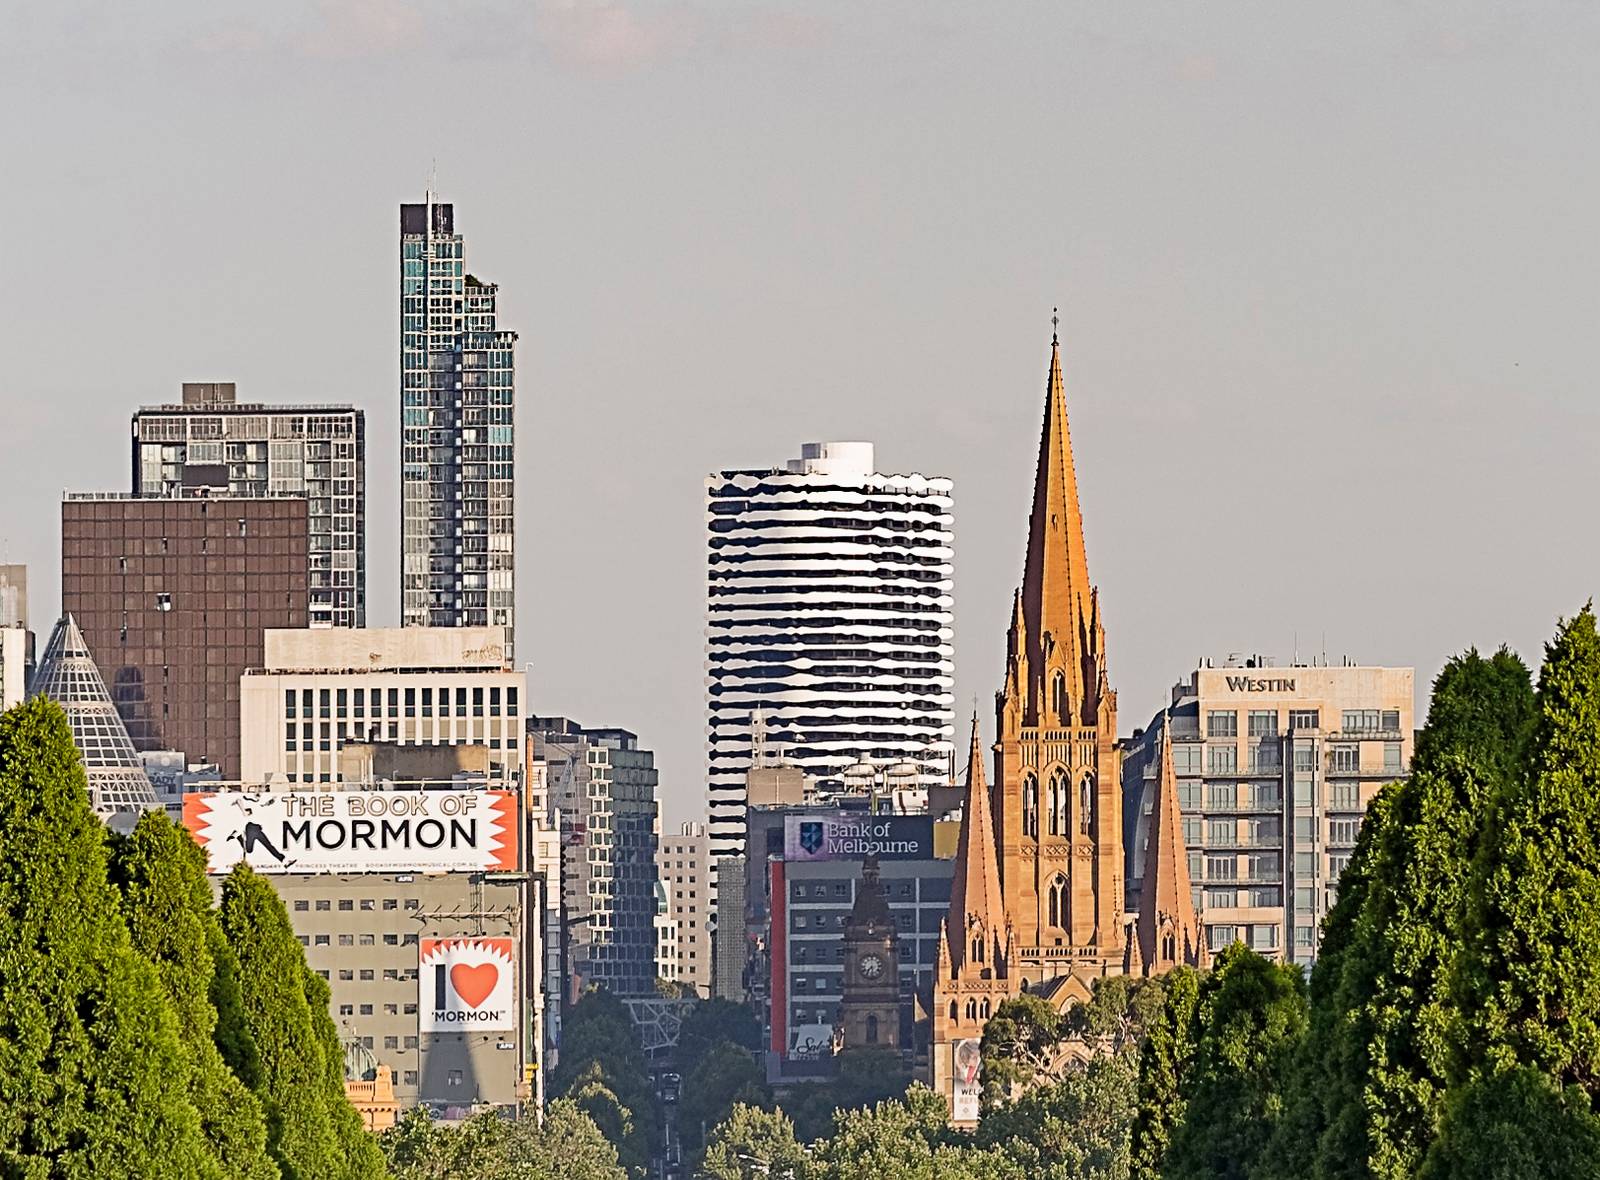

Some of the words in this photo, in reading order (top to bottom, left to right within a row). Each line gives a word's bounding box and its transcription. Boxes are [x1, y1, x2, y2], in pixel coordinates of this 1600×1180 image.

[281, 796, 335, 817] THE
[348, 795, 429, 817] BOOK
[440, 795, 478, 816] OF
[282, 819, 477, 849] MORMON
[828, 822, 871, 838] Bank
[873, 822, 891, 837] of
[828, 839, 919, 854] Melbourne
